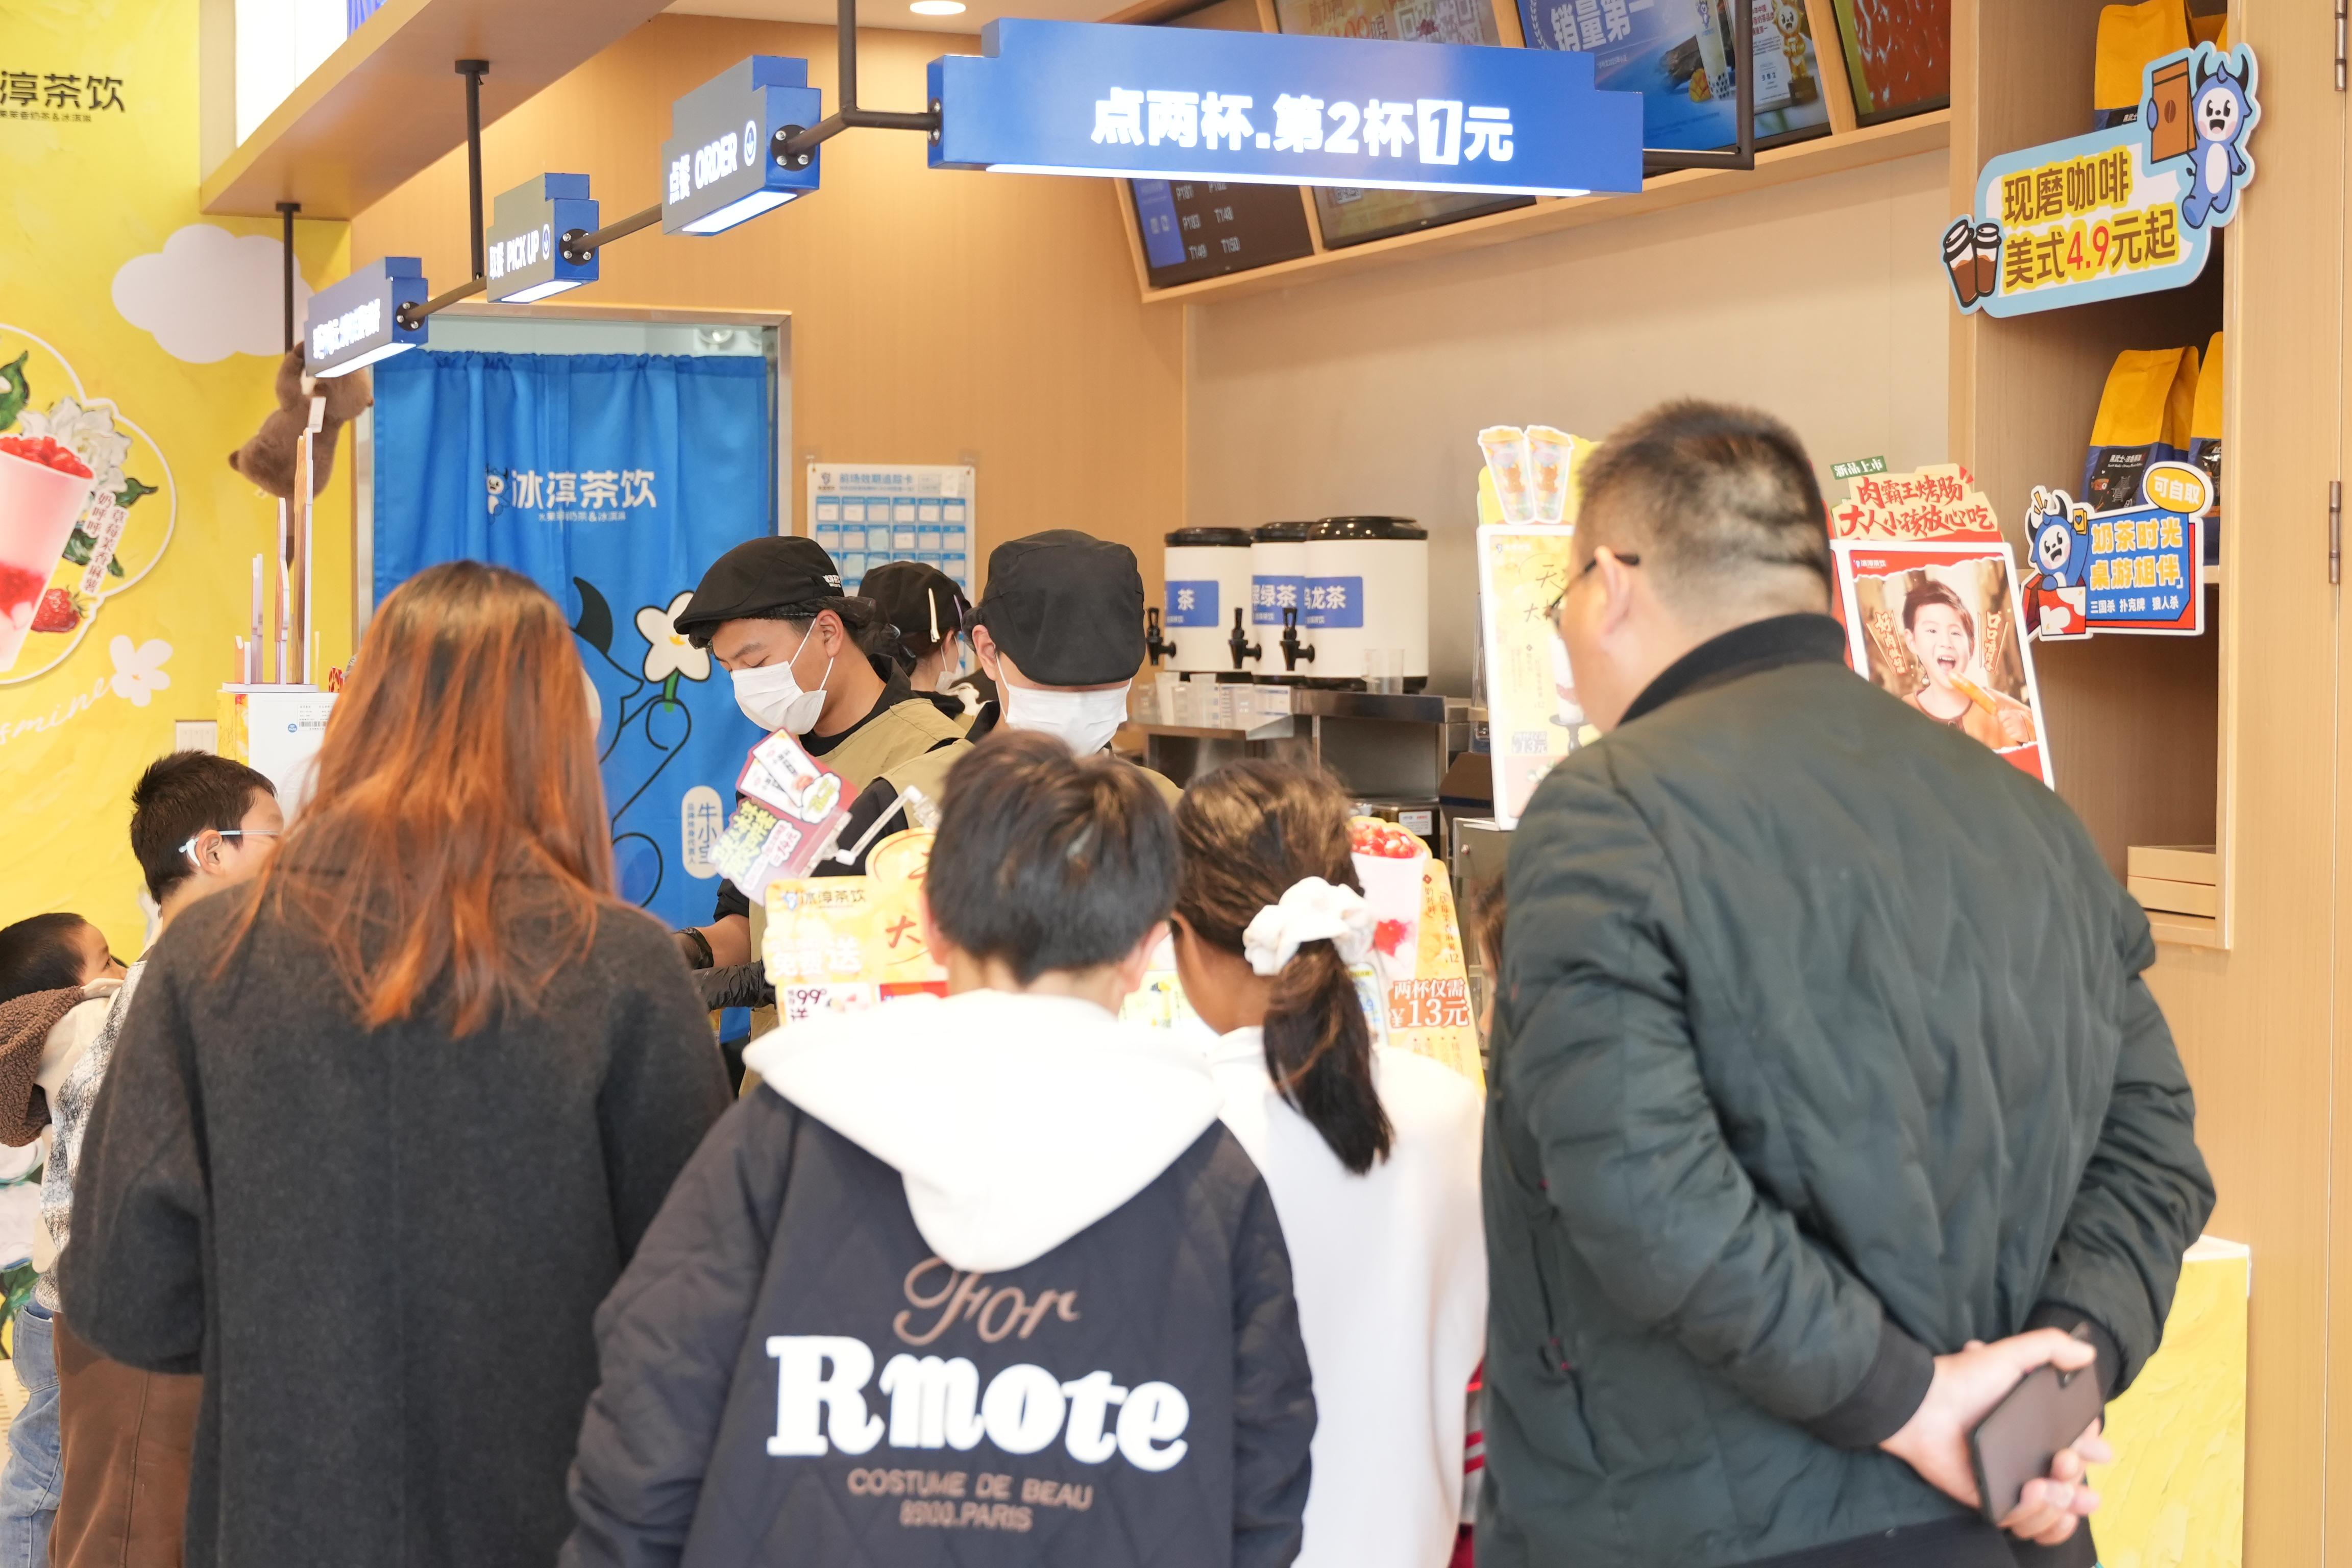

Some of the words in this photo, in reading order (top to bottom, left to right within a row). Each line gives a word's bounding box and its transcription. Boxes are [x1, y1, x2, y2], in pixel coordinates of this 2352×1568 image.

[695, 132, 738, 189] ORDER
[2004, 152, 2129, 224] 现磨咖啡
[507, 235, 526, 272] PICK
[527, 230, 540, 264] UP
[2005, 208, 2176, 288] 美式4.9元起
[1833, 458, 1883, 478] 新品上市
[511, 469, 657, 509] 冰淳茶饮
[1856, 474, 1963, 509] 肉霸王烤肠
[2153, 476, 2201, 505] 可自取
[1838, 504, 1996, 538] 大人小孩放心吃
[2091, 517, 2183, 554] 奶茶时光
[2090, 599, 2116, 614] 三国杀
[2119, 597, 2145, 612] 扑克牌
[2152, 595, 2179, 610] 狼人杀
[801, 889, 867, 904] 冰淳茶饮
[1394, 979, 1465, 999] 两杯仅需
[1391, 998, 1469, 1027] ¥13元
[893, 1257, 1080, 1345] For
[766, 1334, 1190, 1472] Rmote
[847, 1467, 968, 1498] COSTUME
[975, 1473, 1013, 1500] DE
[1021, 1478, 1095, 1511] BEAU
